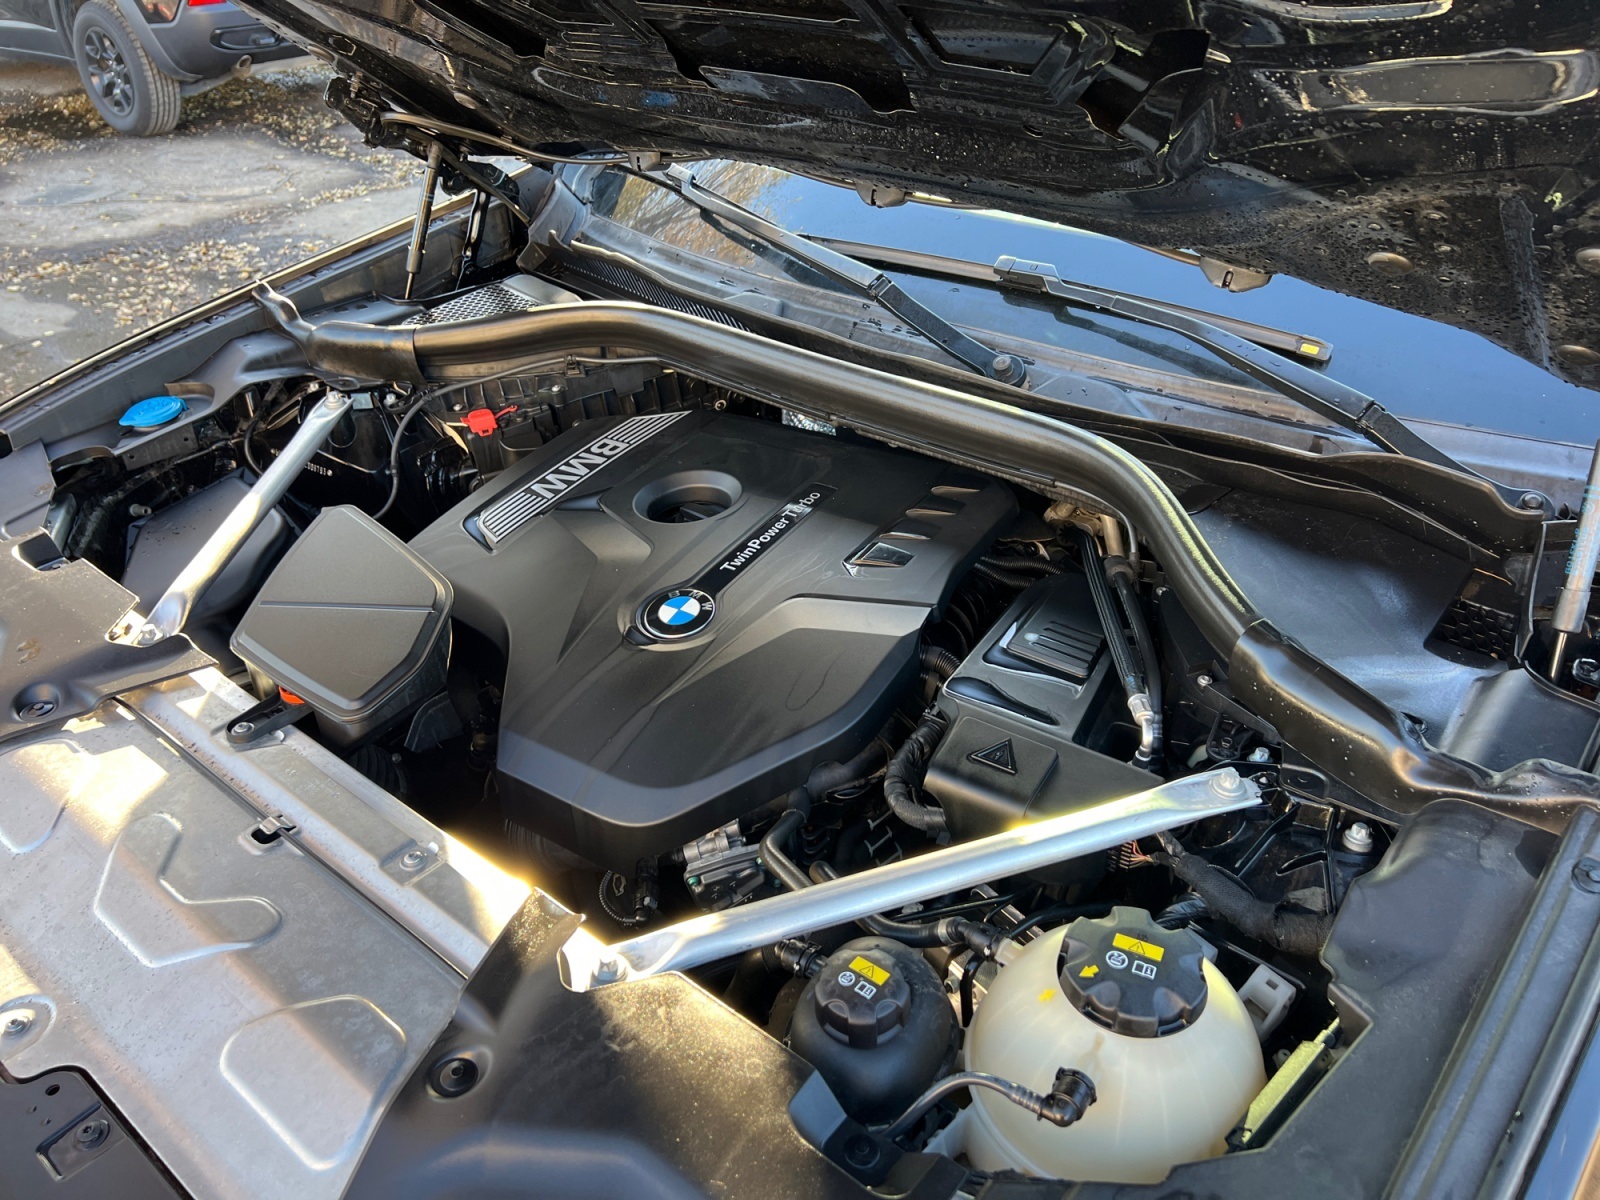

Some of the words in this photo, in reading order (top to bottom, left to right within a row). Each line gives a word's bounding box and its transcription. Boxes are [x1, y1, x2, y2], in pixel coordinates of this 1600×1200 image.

[530, 437, 630, 500] BMW
[719, 516, 790, 572] TwinPower
[781, 492, 821, 518] Turbo
[667, 590, 713, 611] BMW
